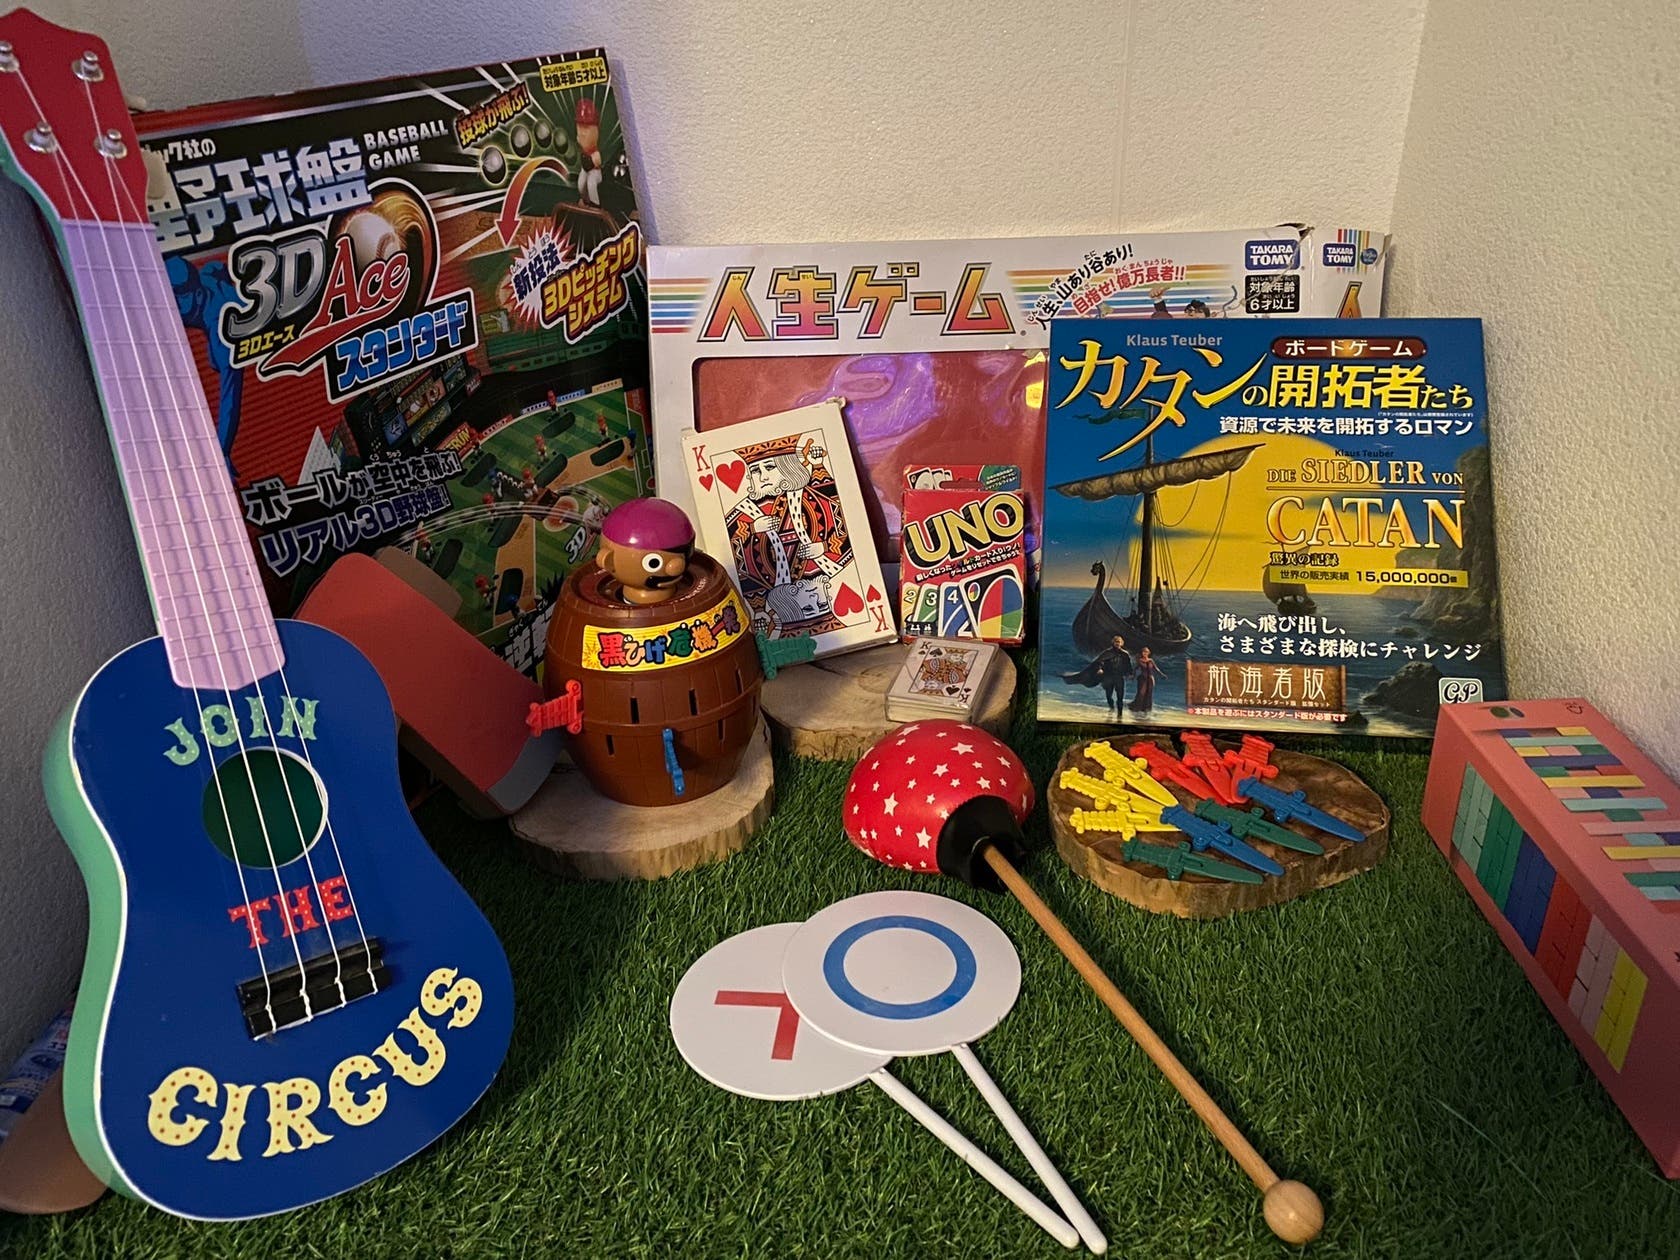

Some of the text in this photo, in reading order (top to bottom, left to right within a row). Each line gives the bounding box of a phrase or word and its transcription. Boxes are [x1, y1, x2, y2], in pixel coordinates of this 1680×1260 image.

[544, 70, 606, 89] 対象年齢5才以上
[364, 119, 449, 147] BASEBALL
[368, 144, 421, 171] GAME
[1250, 244, 1294, 255] TAKARA
[1250, 254, 1294, 266] TOMY
[1326, 246, 1354, 255] TAKARA
[1326, 255, 1354, 264] TOMY
[512, 242, 562, 301] 新投法
[543, 230, 636, 319] 3Dピッチング
[229, 236, 409, 338] 3D Ace
[1250, 281, 1295, 294] 対象年齢
[568, 278, 623, 332] システム
[697, 262, 1015, 343] 人生ゲーム
[1250, 298, 1295, 311] 6才以上
[237, 325, 296, 359] 3Dエース
[336, 300, 468, 392] スタンダード
[1126, 334, 1223, 346] Klaus Teuber
[1285, 340, 1413, 357] ボードゲーム
[1055, 340, 1474, 461] カタンの開拓者たち
[1219, 416, 1473, 436] 資源で未来を開拓するロマン
[692, 444, 711, 472] K
[1335, 449, 1394, 458] Klaus Teuber
[1267, 457, 1465, 486] DIE SIEDLER VON
[241, 450, 463, 526] ボールが空中を飛ぶ!
[258, 481, 452, 578] リアル3D野球盤!
[903, 492, 1024, 571] UNO
[1266, 495, 1466, 549] CATAN
[1269, 551, 1340, 567] 驚異の記録
[1280, 570, 1350, 581] 世界の販売実績
[904, 590, 917, 603] 2
[926, 592, 938, 606] 3
[947, 589, 959, 604] 4
[869, 604, 890, 634] K
[1217, 612, 1349, 635] 海へ飛び出し、
[921, 641, 932, 650] K
[1218, 635, 1482, 661] さまざまな探検にチャレンジ
[1207, 664, 1326, 701] 航海者版
[163, 695, 320, 766] JOIN
[227, 875, 354, 949] THE
[148, 967, 483, 1161] CIRCUS
